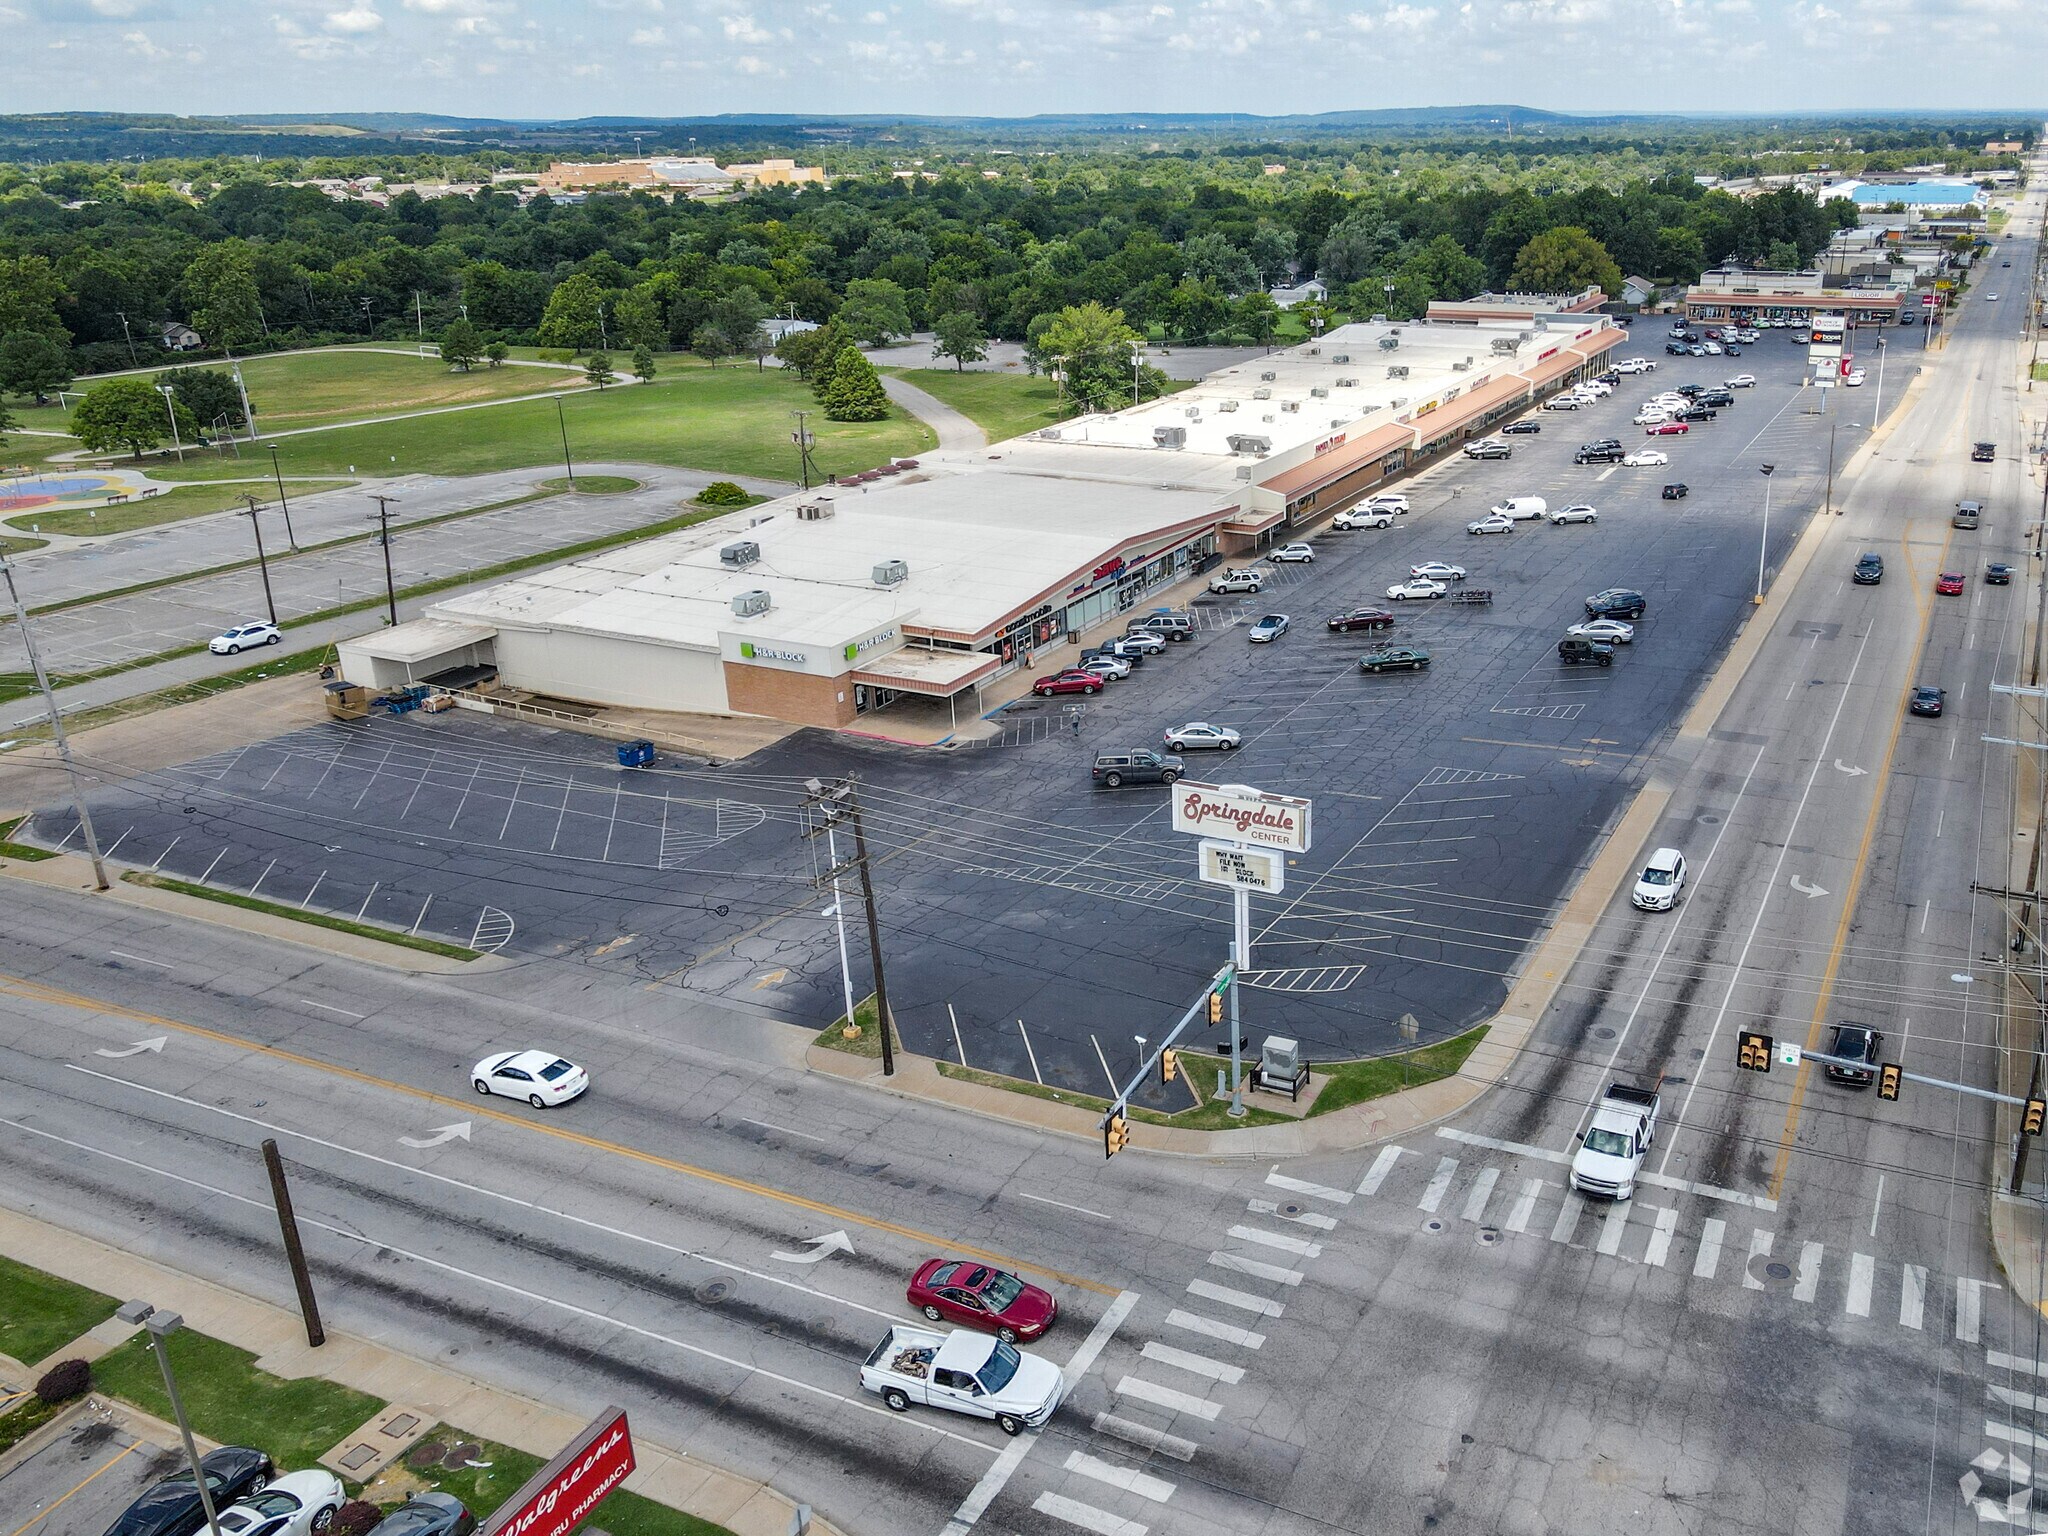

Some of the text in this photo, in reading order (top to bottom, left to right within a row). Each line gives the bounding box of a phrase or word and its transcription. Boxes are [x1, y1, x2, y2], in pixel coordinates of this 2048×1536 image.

[858, 628, 897, 651] H&R BLOCK
[755, 647, 805, 662] H&R BLOCK
[1183, 793, 1294, 832] Springdale
[1251, 831, 1290, 845] CENTER
[572, 1459, 629, 1521] PHARMACY
